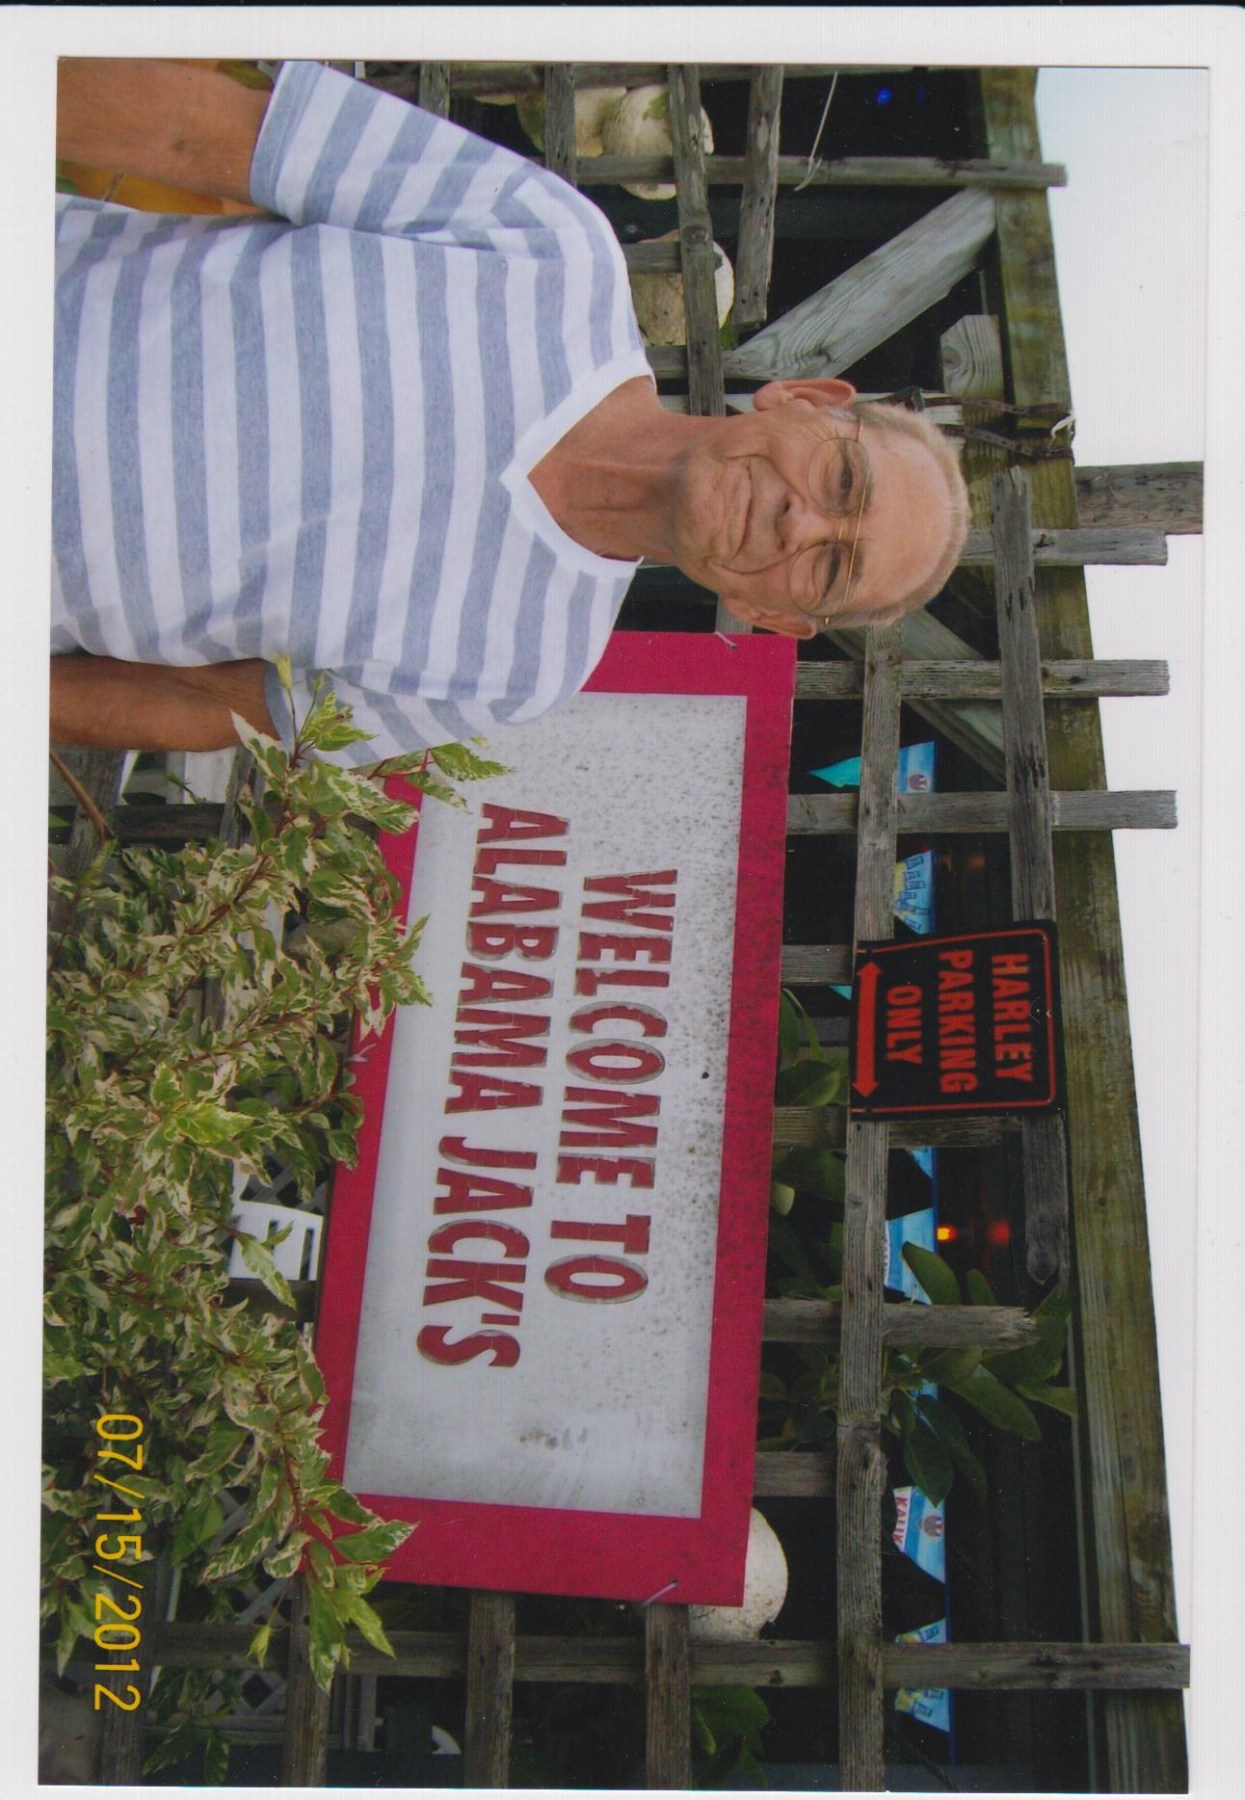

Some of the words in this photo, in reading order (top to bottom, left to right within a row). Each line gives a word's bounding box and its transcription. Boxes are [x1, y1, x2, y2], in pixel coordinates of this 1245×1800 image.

[444, 803, 570, 1114] ALABAMA
[555, 869, 678, 1189] WELCOME
[886, 985, 923, 1064] ONLY
[938, 949, 978, 1093] PARKING
[991, 953, 1034, 1082] HARLEY
[416, 1136, 538, 1368] JACK'S
[544, 1214, 651, 1304] TO
